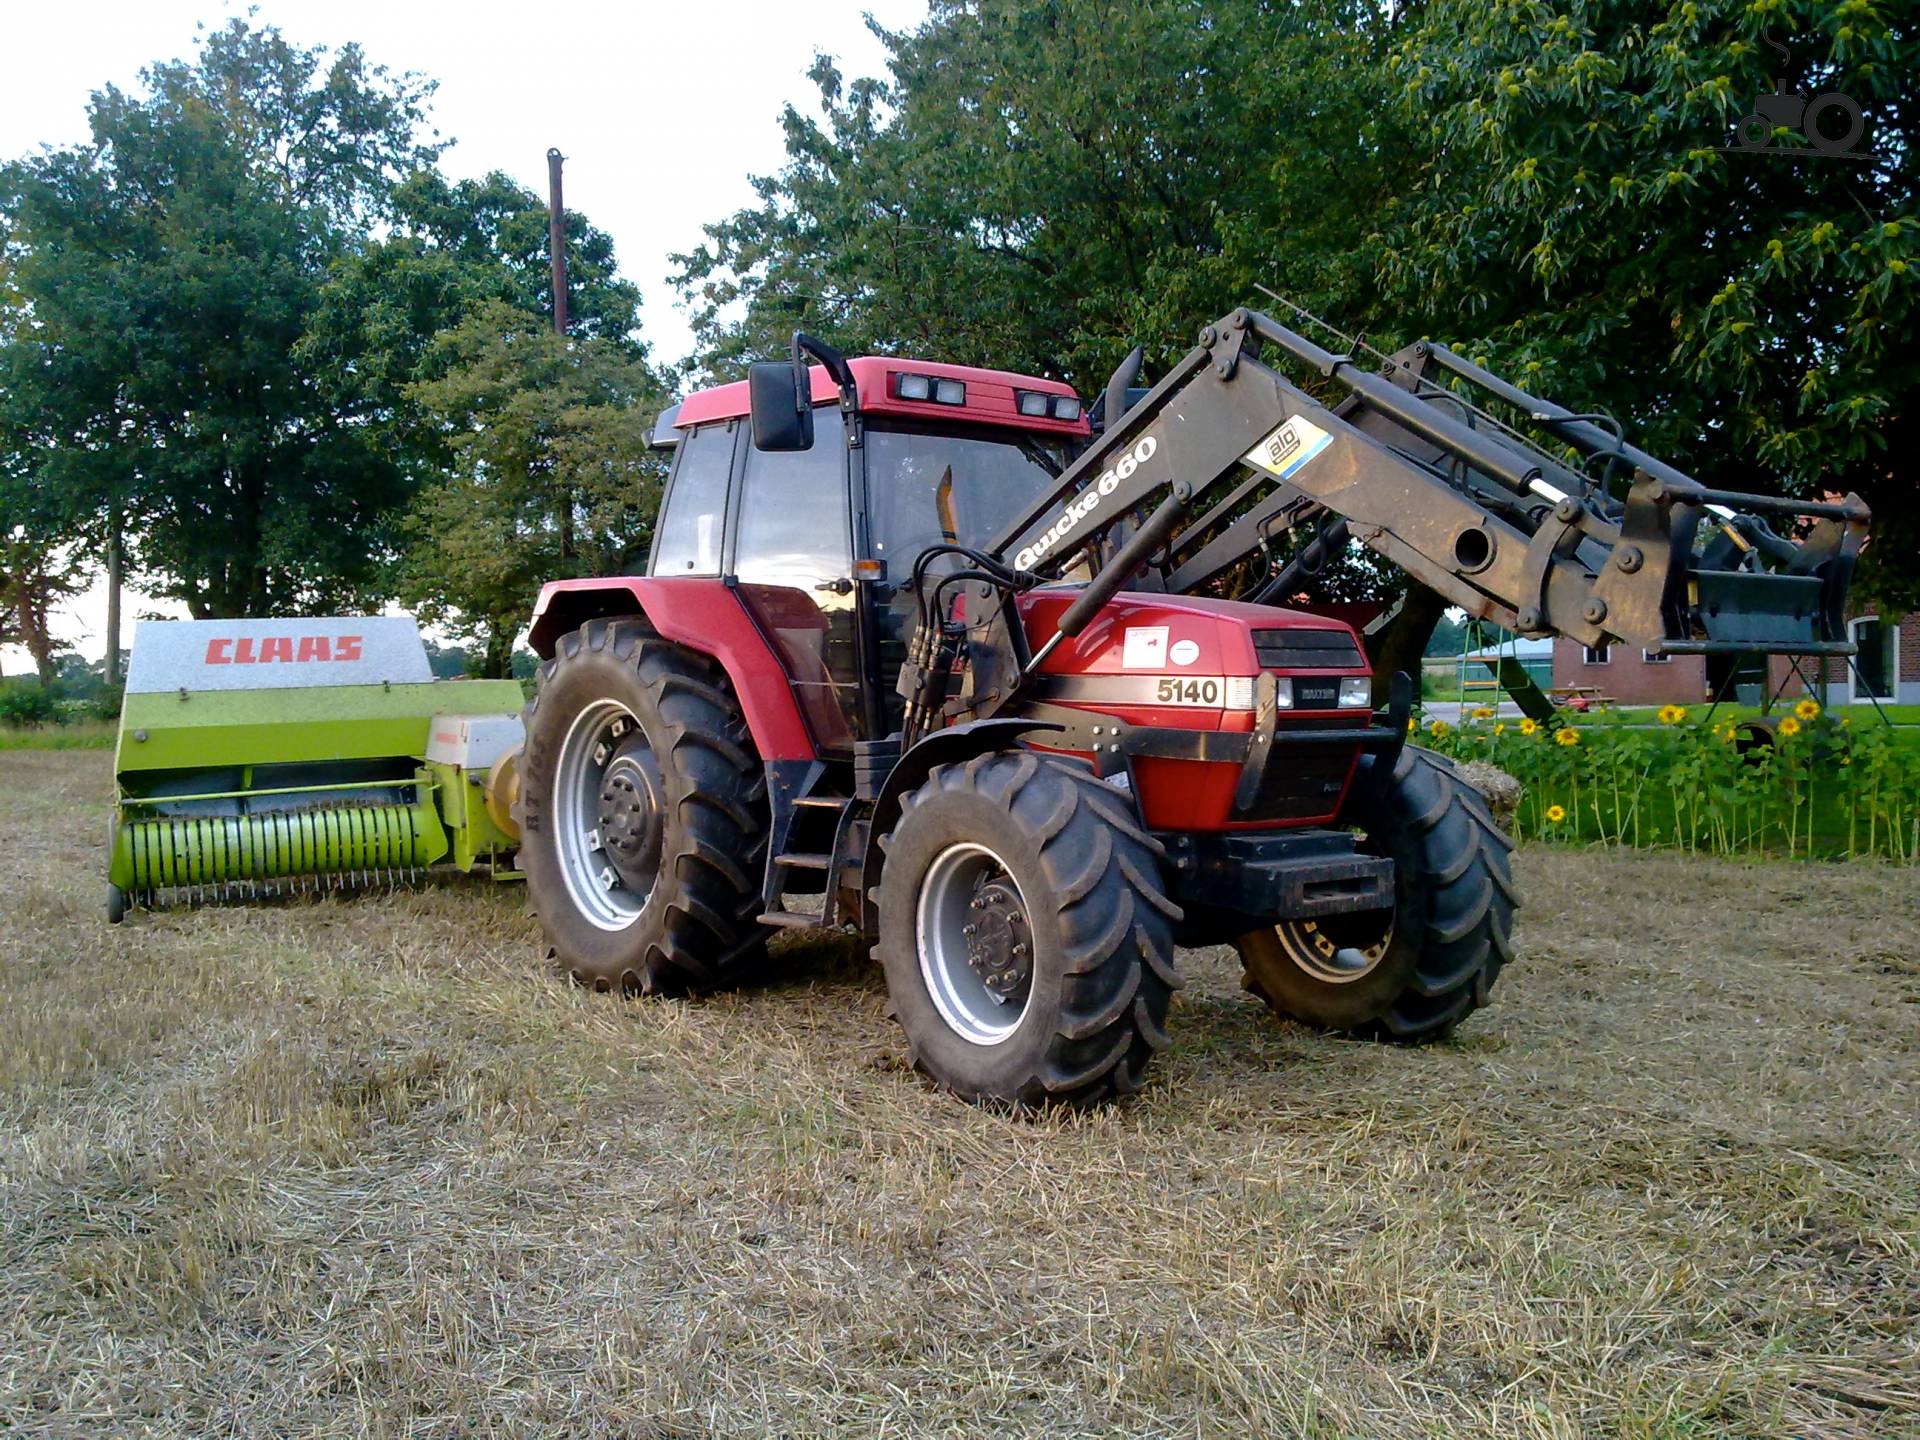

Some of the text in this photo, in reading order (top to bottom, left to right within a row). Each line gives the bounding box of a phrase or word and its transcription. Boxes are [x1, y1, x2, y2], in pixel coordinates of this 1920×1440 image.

[1270, 430, 1295, 457] alo
[1014, 436, 1157, 571] Quicke 660
[206, 636, 363, 664] CLAAS
[1157, 679, 1217, 703] 5140
